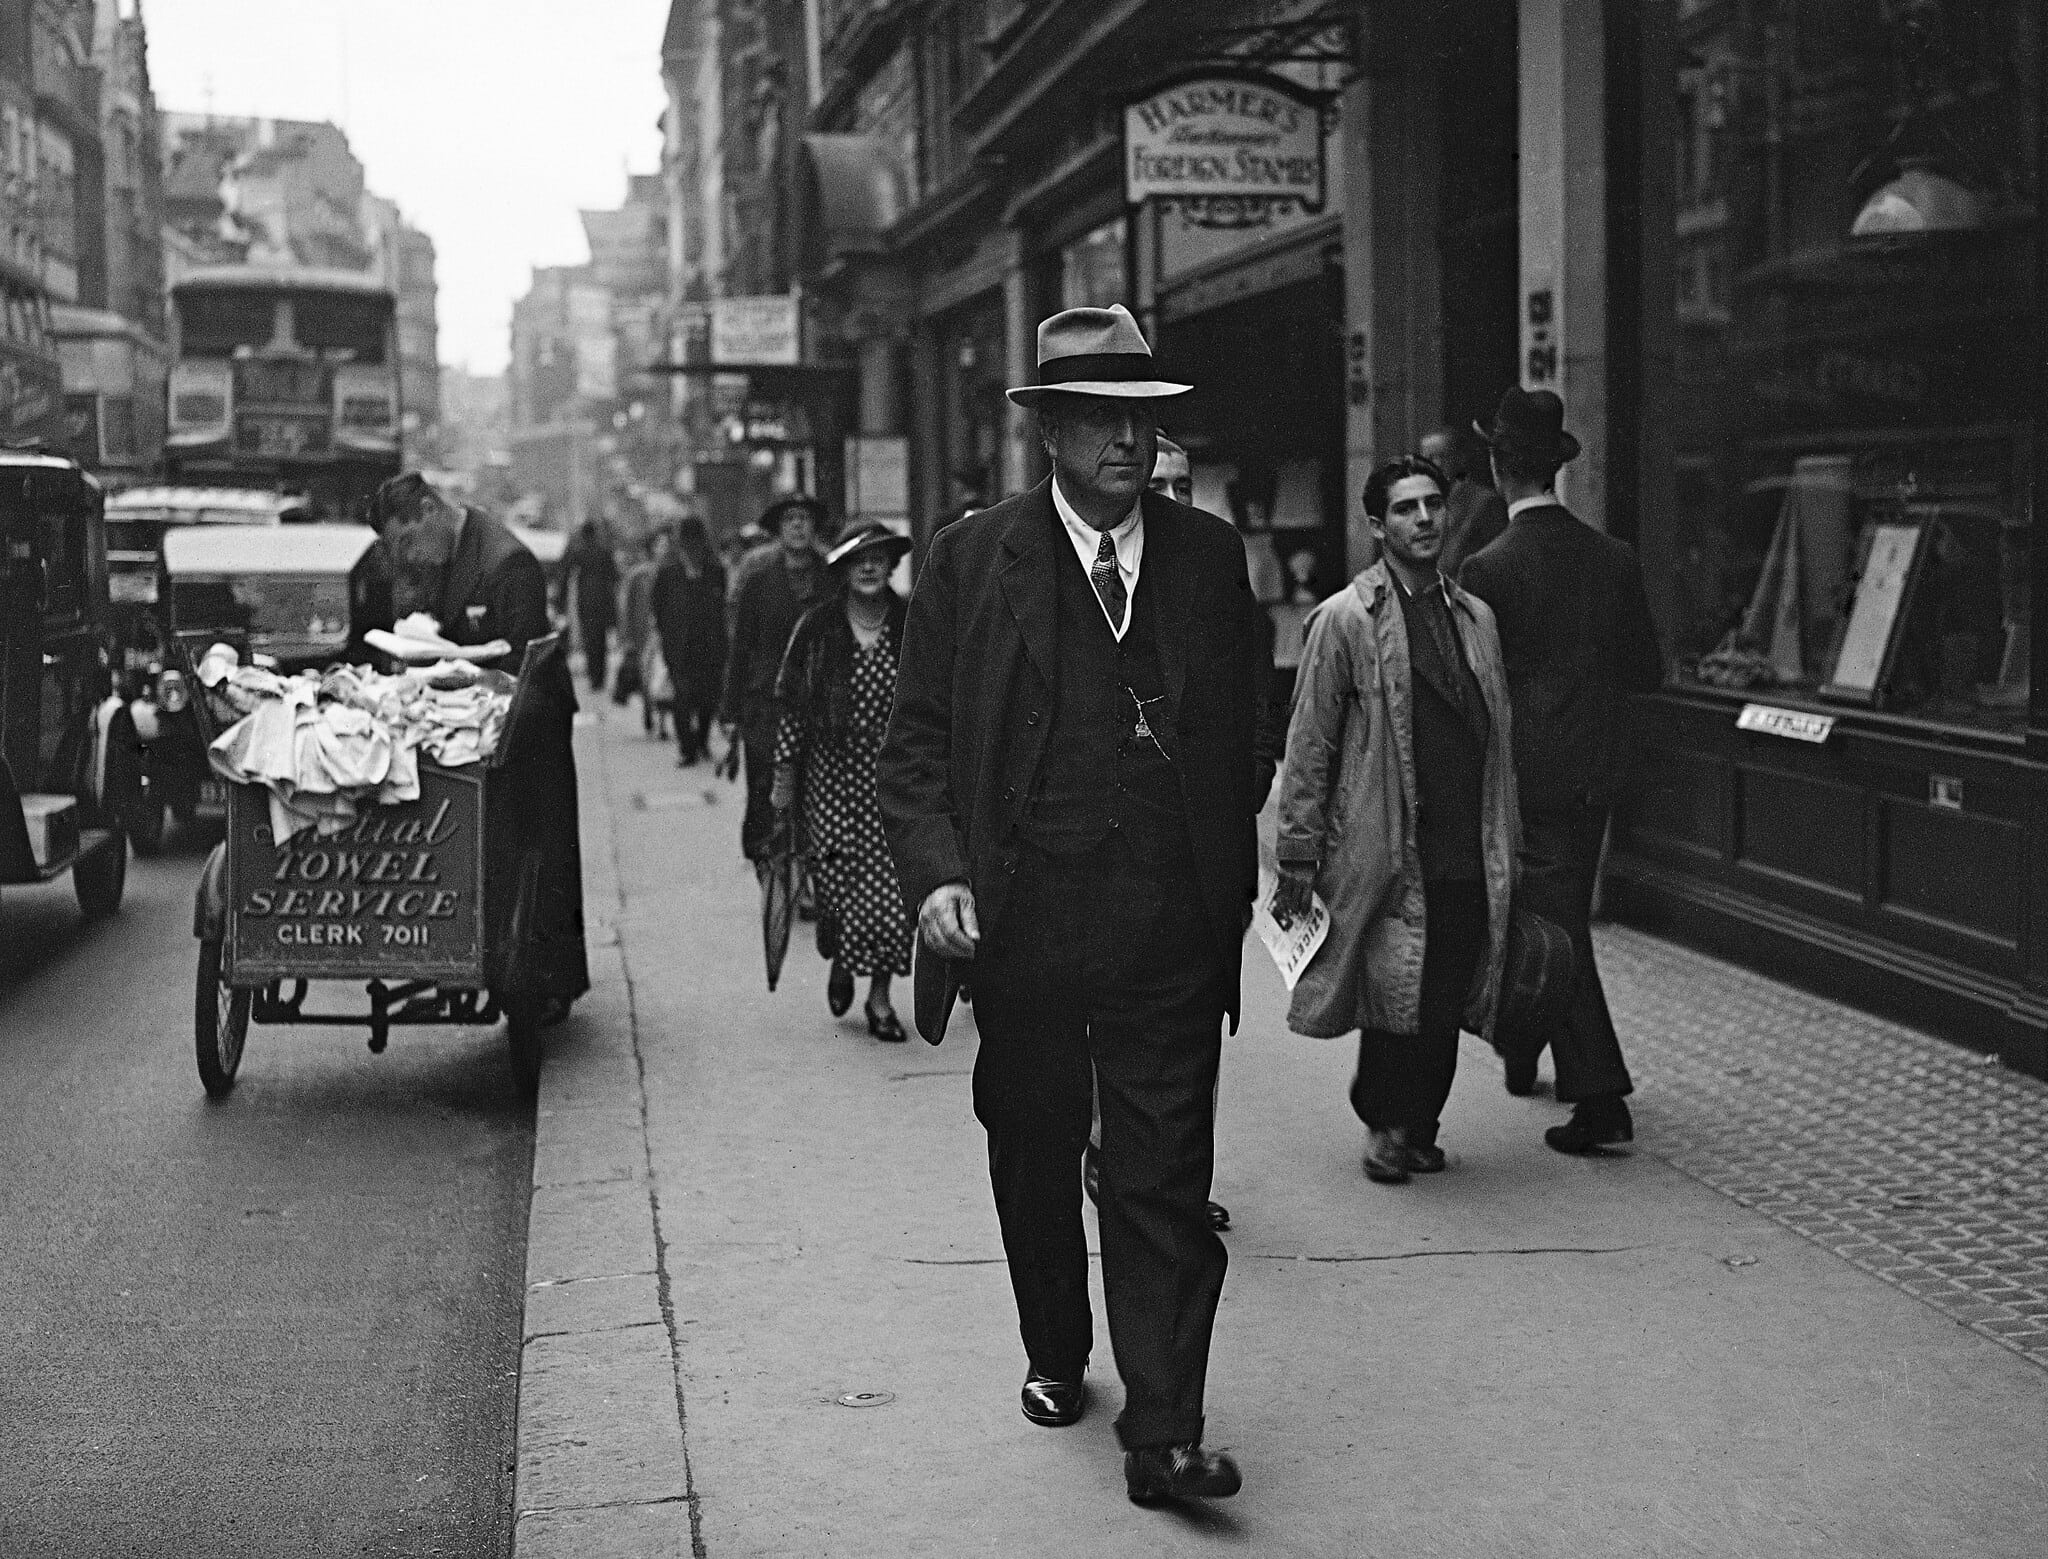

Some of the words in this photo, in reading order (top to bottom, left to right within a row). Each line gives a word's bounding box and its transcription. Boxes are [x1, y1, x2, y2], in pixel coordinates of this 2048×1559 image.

[1132, 145, 1228, 183] FOREIGN
[254, 799, 458, 846] tial
[274, 851, 438, 881] TOWEL
[243, 889, 458, 917] SERVICE
[277, 924, 363, 945] CLERK
[381, 924, 429, 945] 7011
